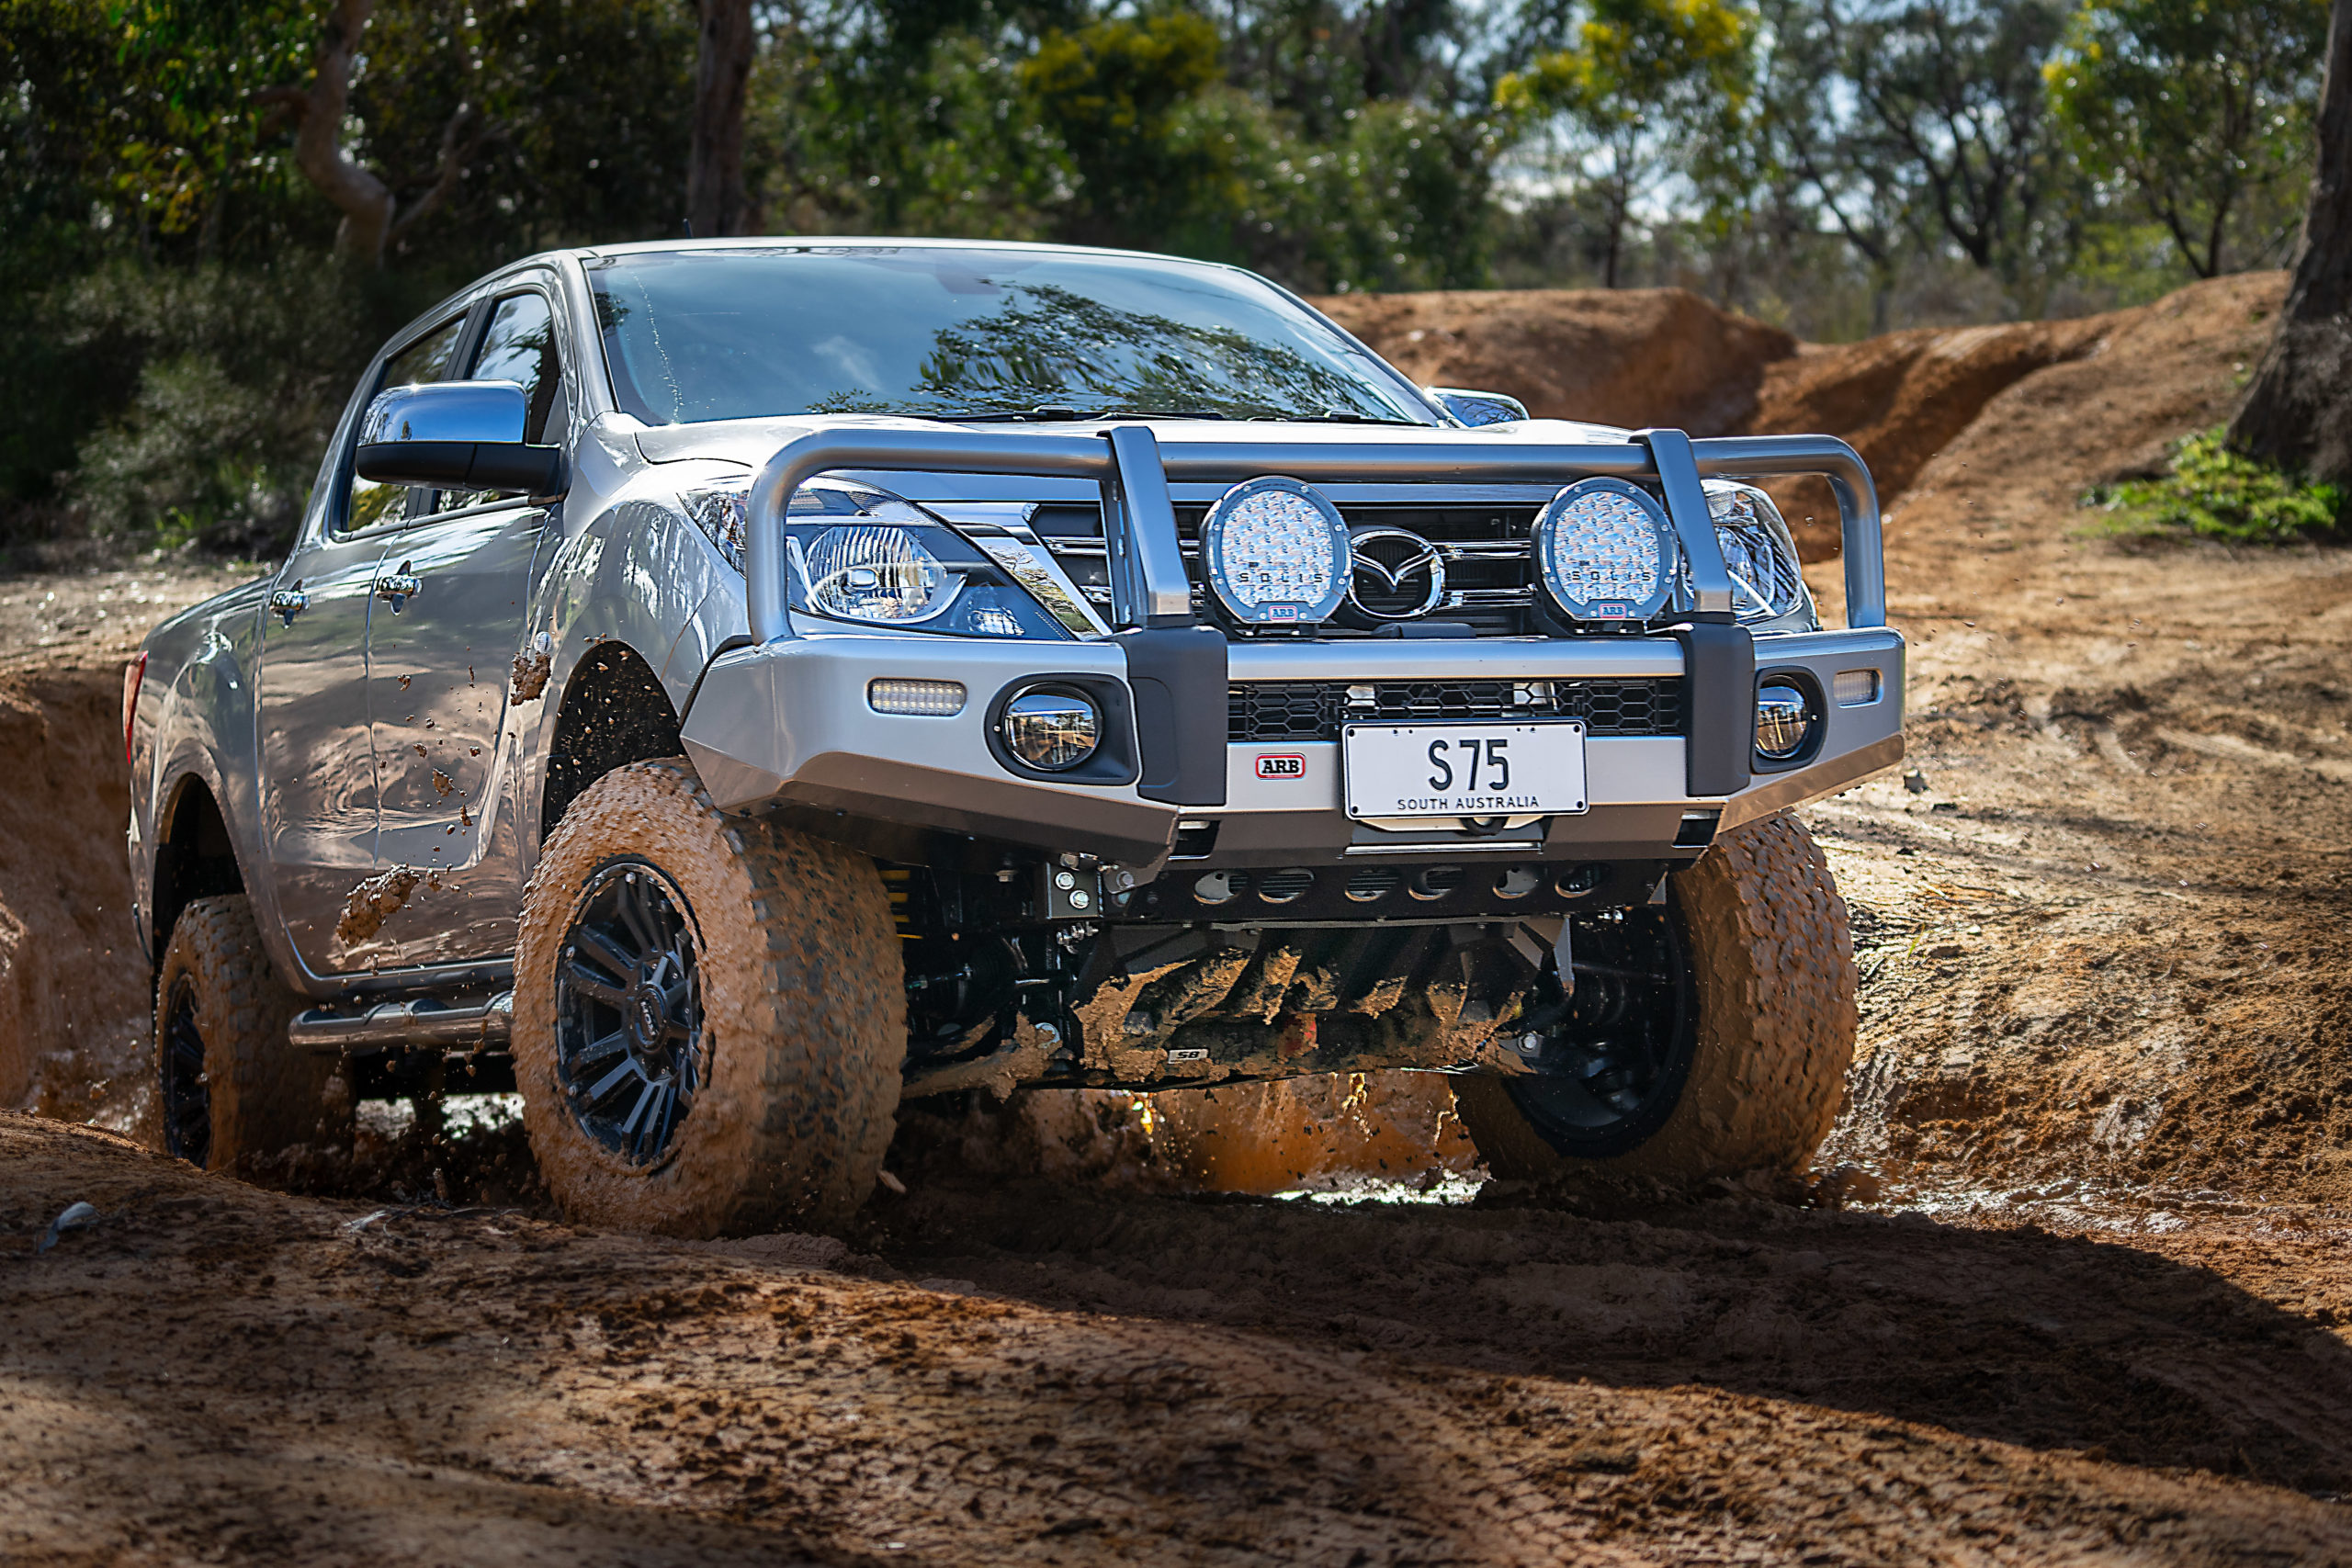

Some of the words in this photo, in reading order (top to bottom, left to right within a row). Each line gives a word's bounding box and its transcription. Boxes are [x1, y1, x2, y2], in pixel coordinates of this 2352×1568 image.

[1272, 608, 1295, 617] ARB
[1602, 606, 1623, 615] ARB
[1261, 760, 1300, 773] ARB
[1429, 739, 1510, 791] S75
[1397, 798, 1448, 810] SOUTH
[1455, 795, 1540, 809] AUSTRALIA
